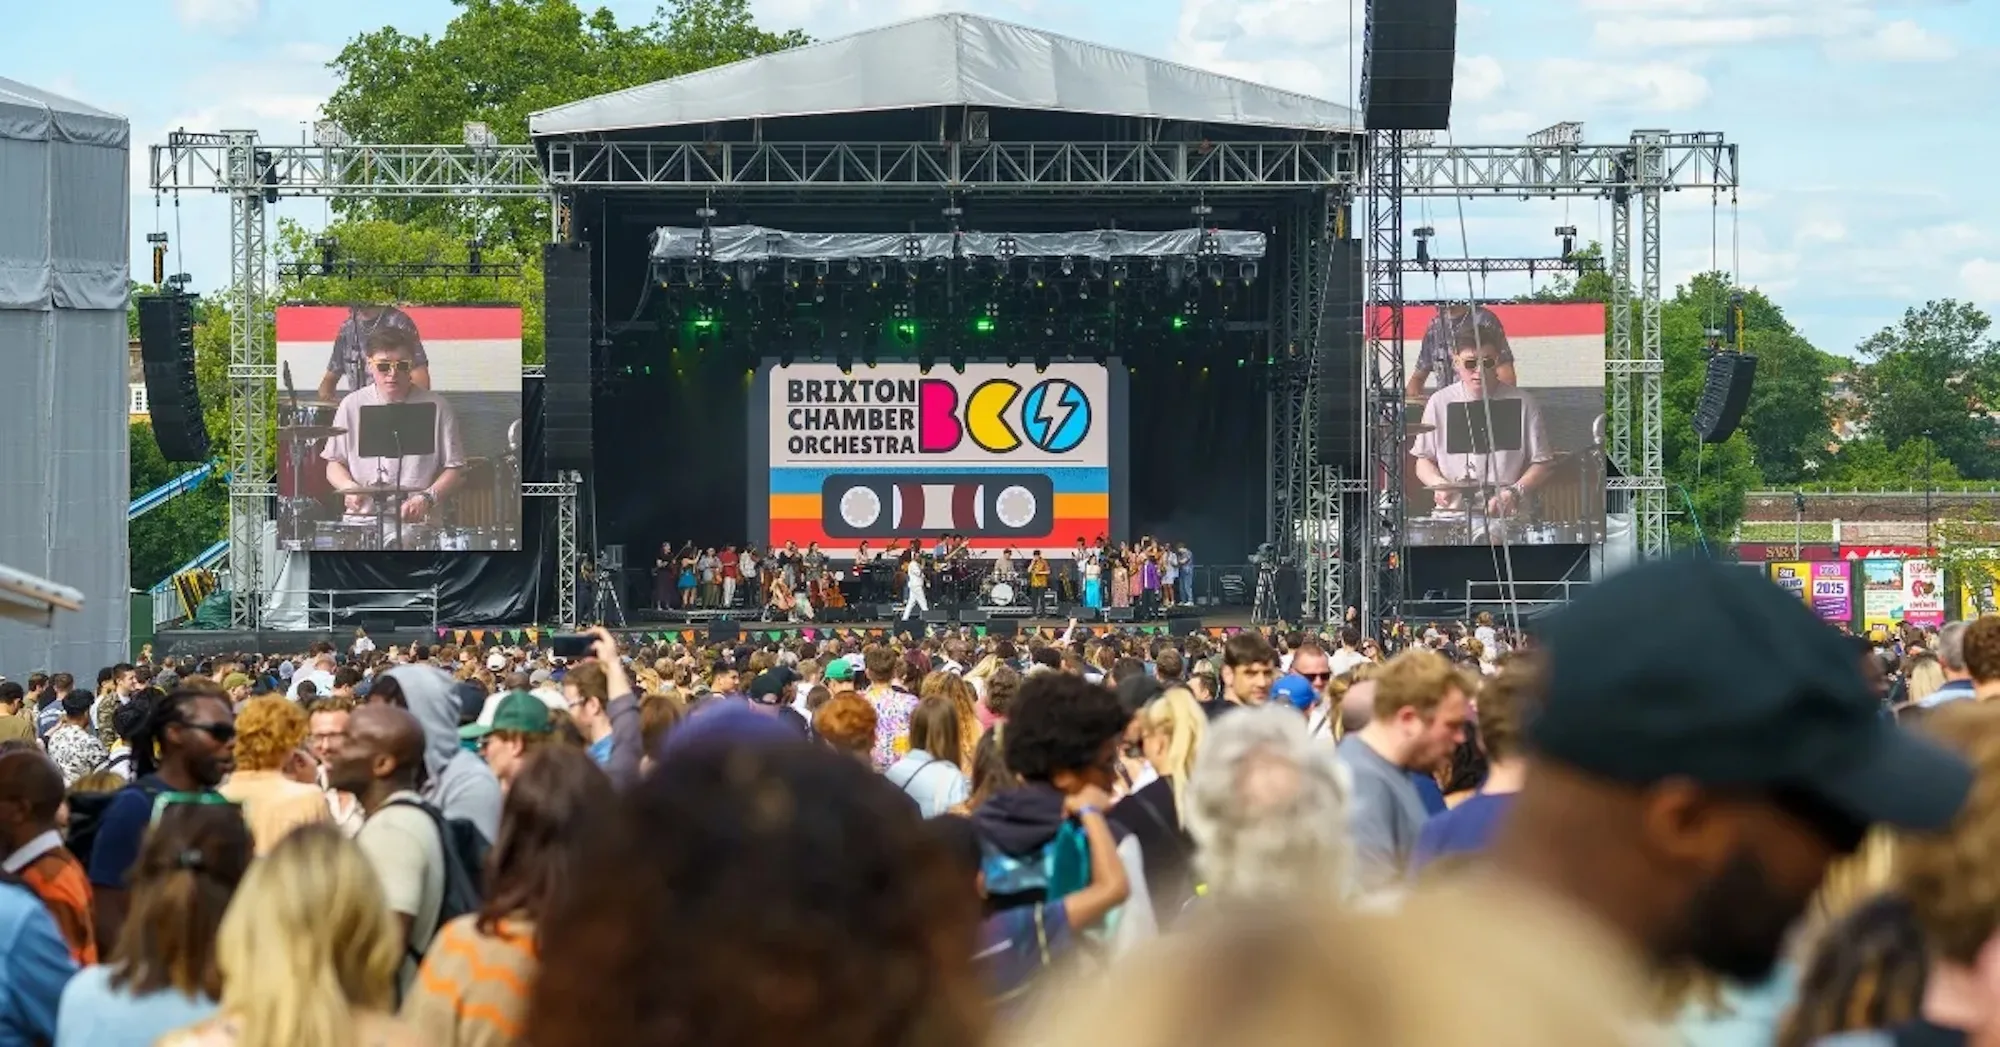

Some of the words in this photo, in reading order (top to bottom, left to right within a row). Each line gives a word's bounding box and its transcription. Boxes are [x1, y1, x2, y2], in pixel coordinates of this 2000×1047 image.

[788, 379, 915, 403] BRIXTON
[788, 408, 915, 431] CHAMBER
[919, 378, 1092, 454] BCO
[788, 436, 915, 454] ORCHESTRA
